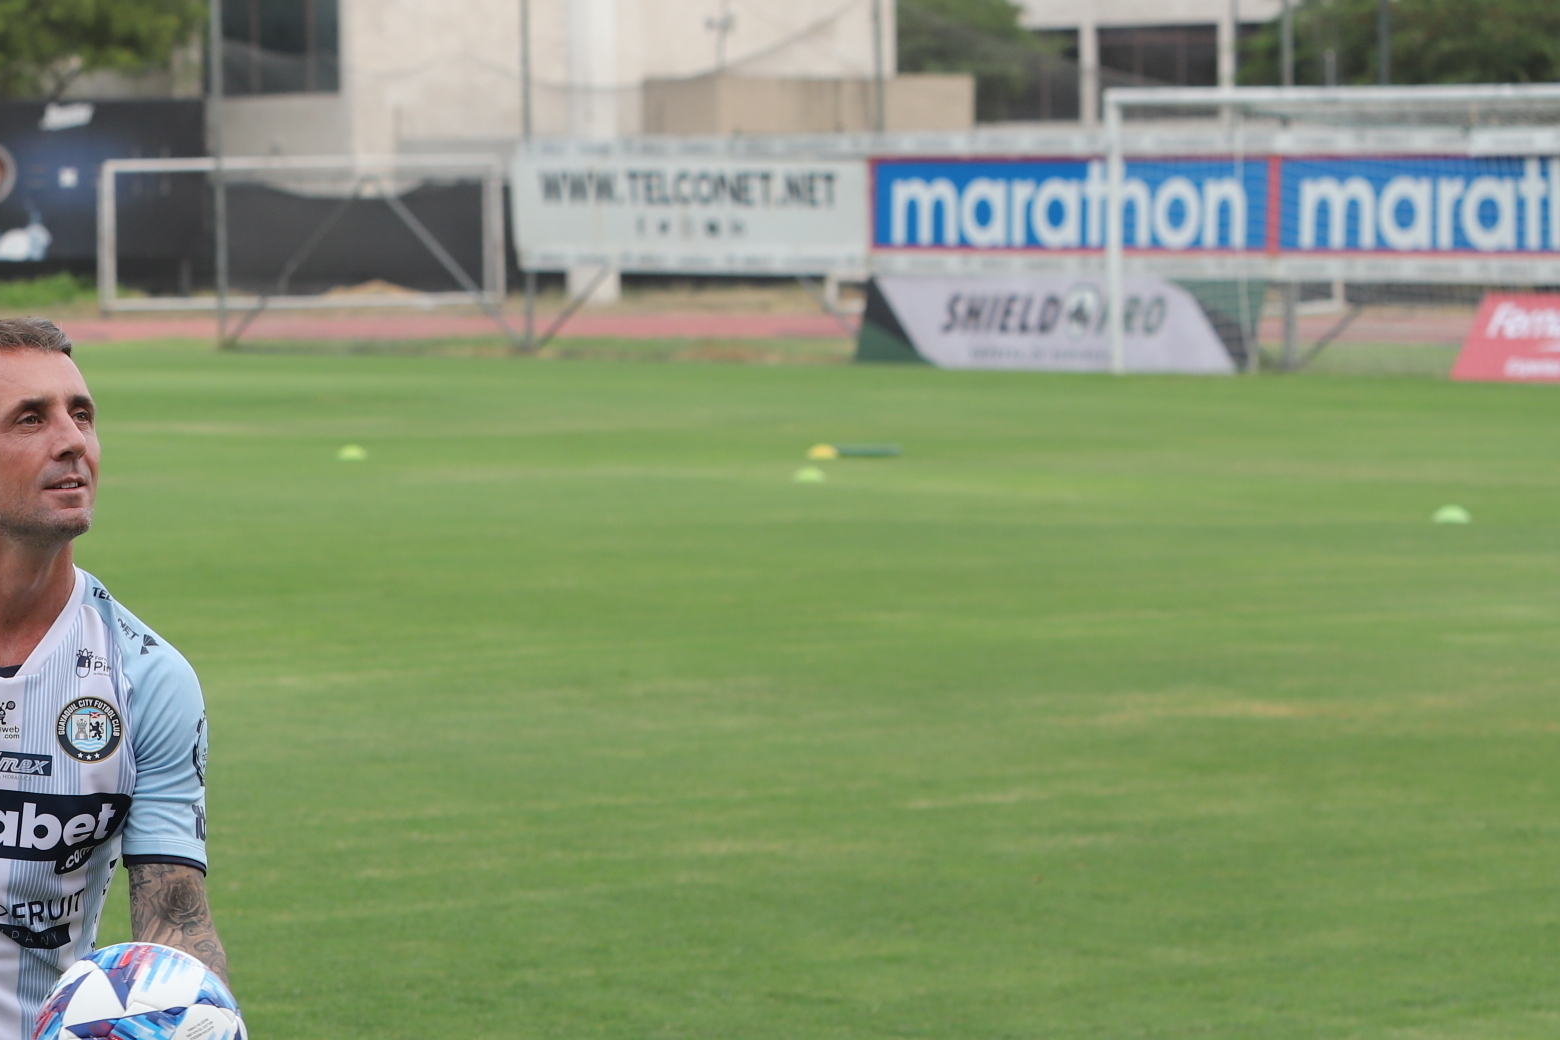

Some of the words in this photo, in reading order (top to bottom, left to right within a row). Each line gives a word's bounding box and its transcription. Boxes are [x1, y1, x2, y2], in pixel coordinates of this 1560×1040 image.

[541, 170, 837, 208] WWW.TELCONET.NET
[942, 292, 1063, 334] SHIELD
[57, 703, 79, 736] GUAYAQUIL
[78, 699, 94, 707] CITY
[93, 700, 116, 720] FUTBOL
[111, 718, 121, 737] CLUB
[60, 845, 95, 870] .com
